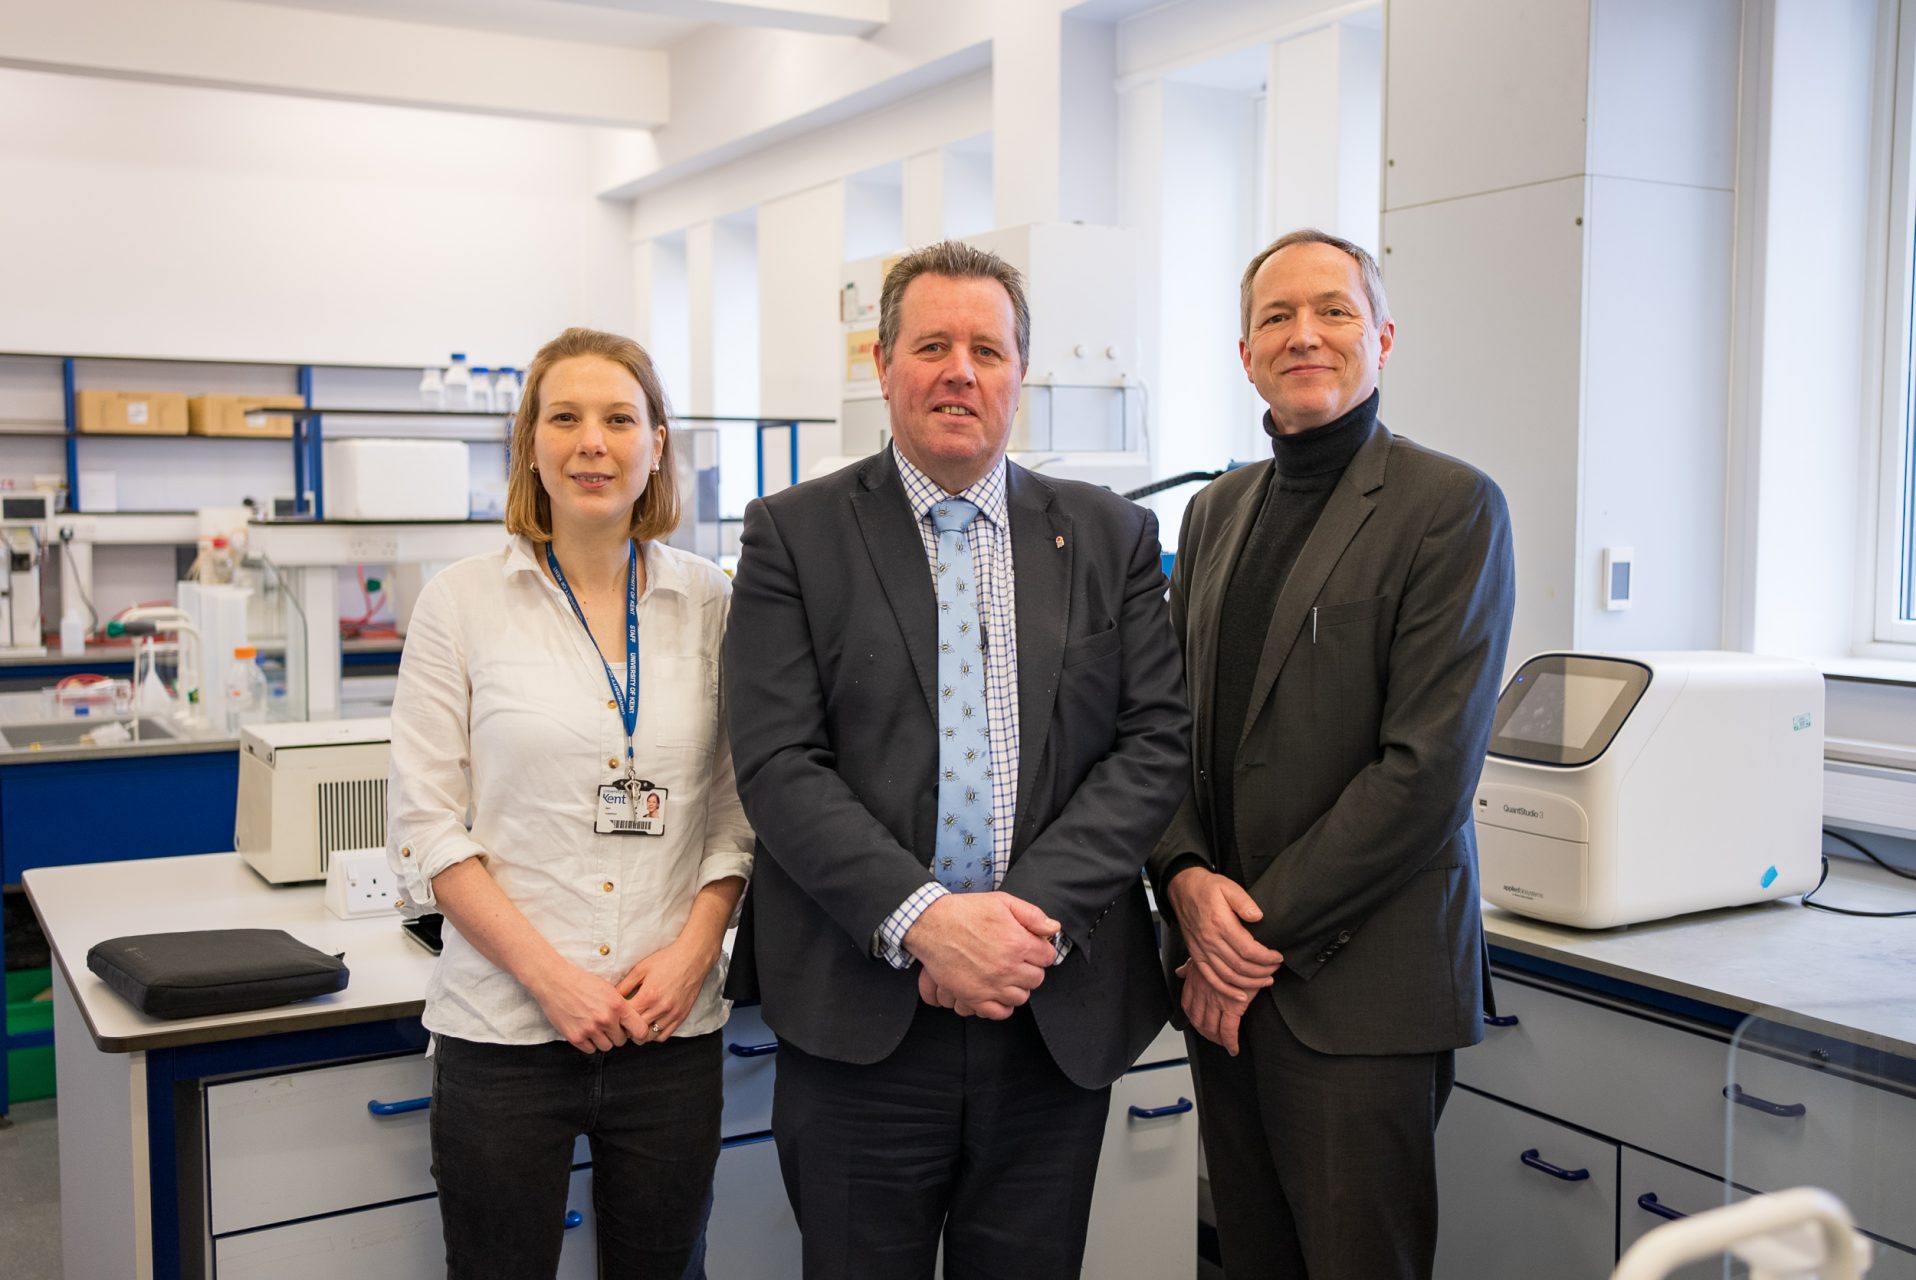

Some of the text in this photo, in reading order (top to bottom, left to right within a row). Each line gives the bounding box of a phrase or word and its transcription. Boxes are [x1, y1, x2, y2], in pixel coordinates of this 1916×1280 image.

[628, 697, 636, 714] KENT
[603, 794, 626, 804] Kent
[1503, 804, 1539, 818] QuantStudio
